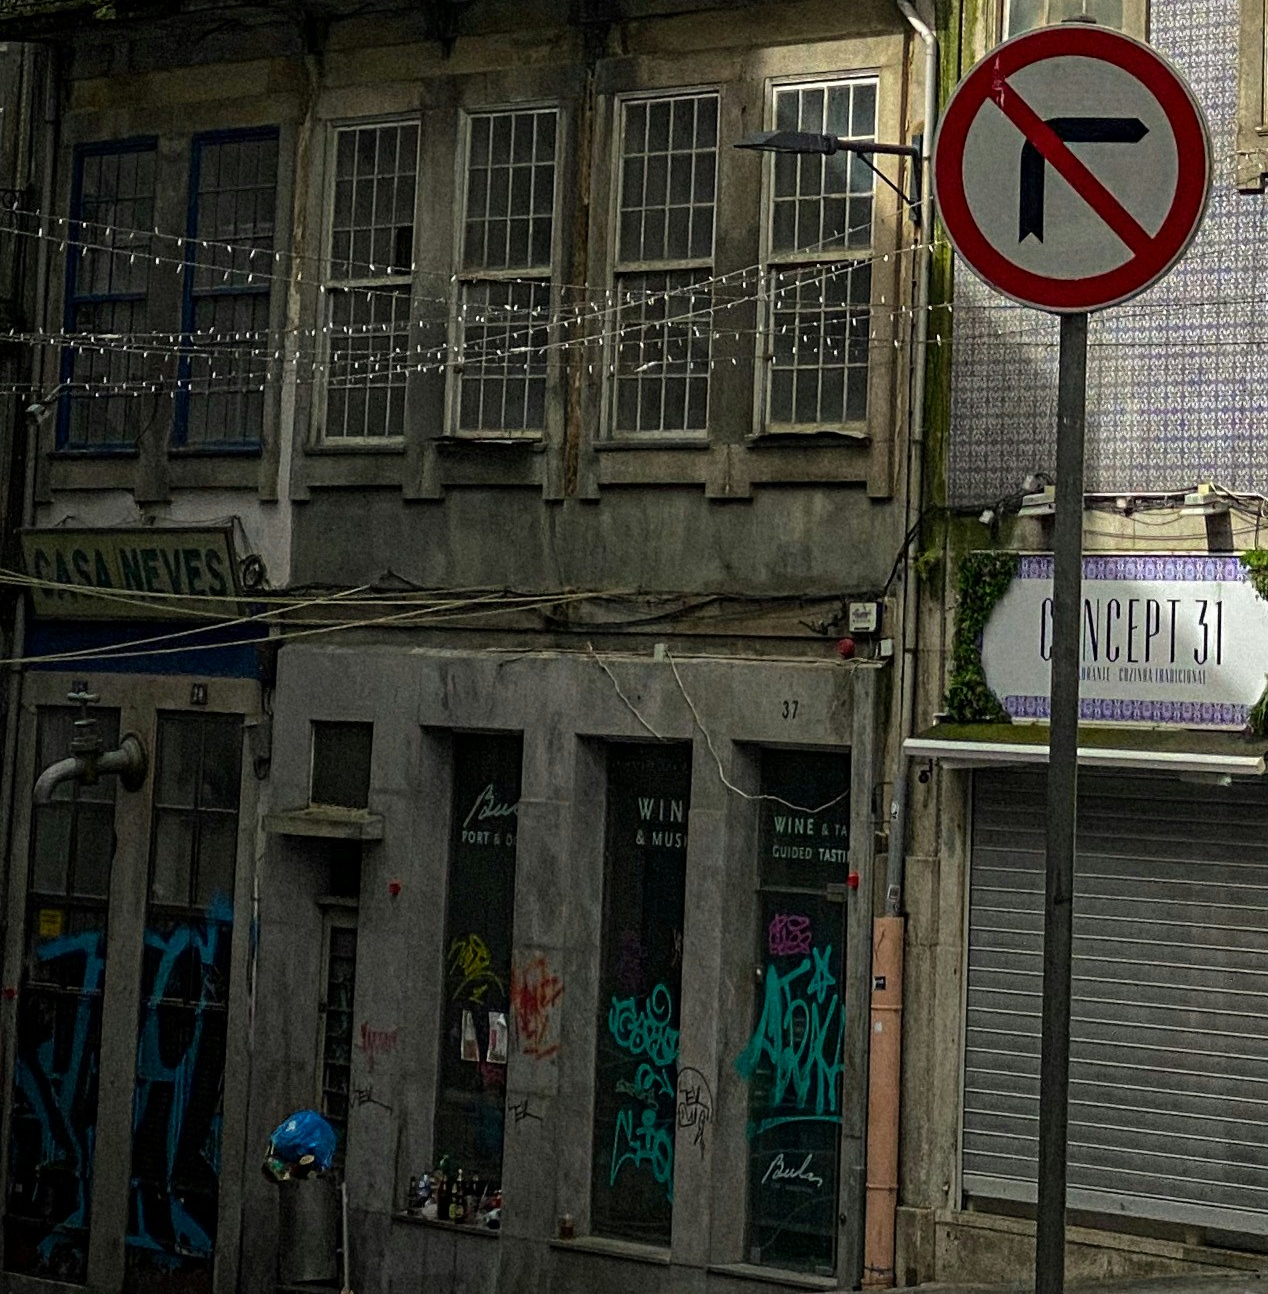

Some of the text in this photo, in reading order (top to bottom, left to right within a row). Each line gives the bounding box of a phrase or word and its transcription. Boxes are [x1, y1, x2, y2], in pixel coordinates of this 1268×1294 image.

[33, 547, 227, 599] CASA NEVES
[1040, 598, 1222, 665] CNCEPT 31
[782, 700, 799, 719] 37
[638, 796, 683, 823] WIN
[774, 816, 814, 835] WINE
[834, 823, 848, 837] TA
[461, 830, 490, 845] PORT
[636, 829, 687, 849] & MUSI
[772, 845, 849, 863] GUIDED TASTI
